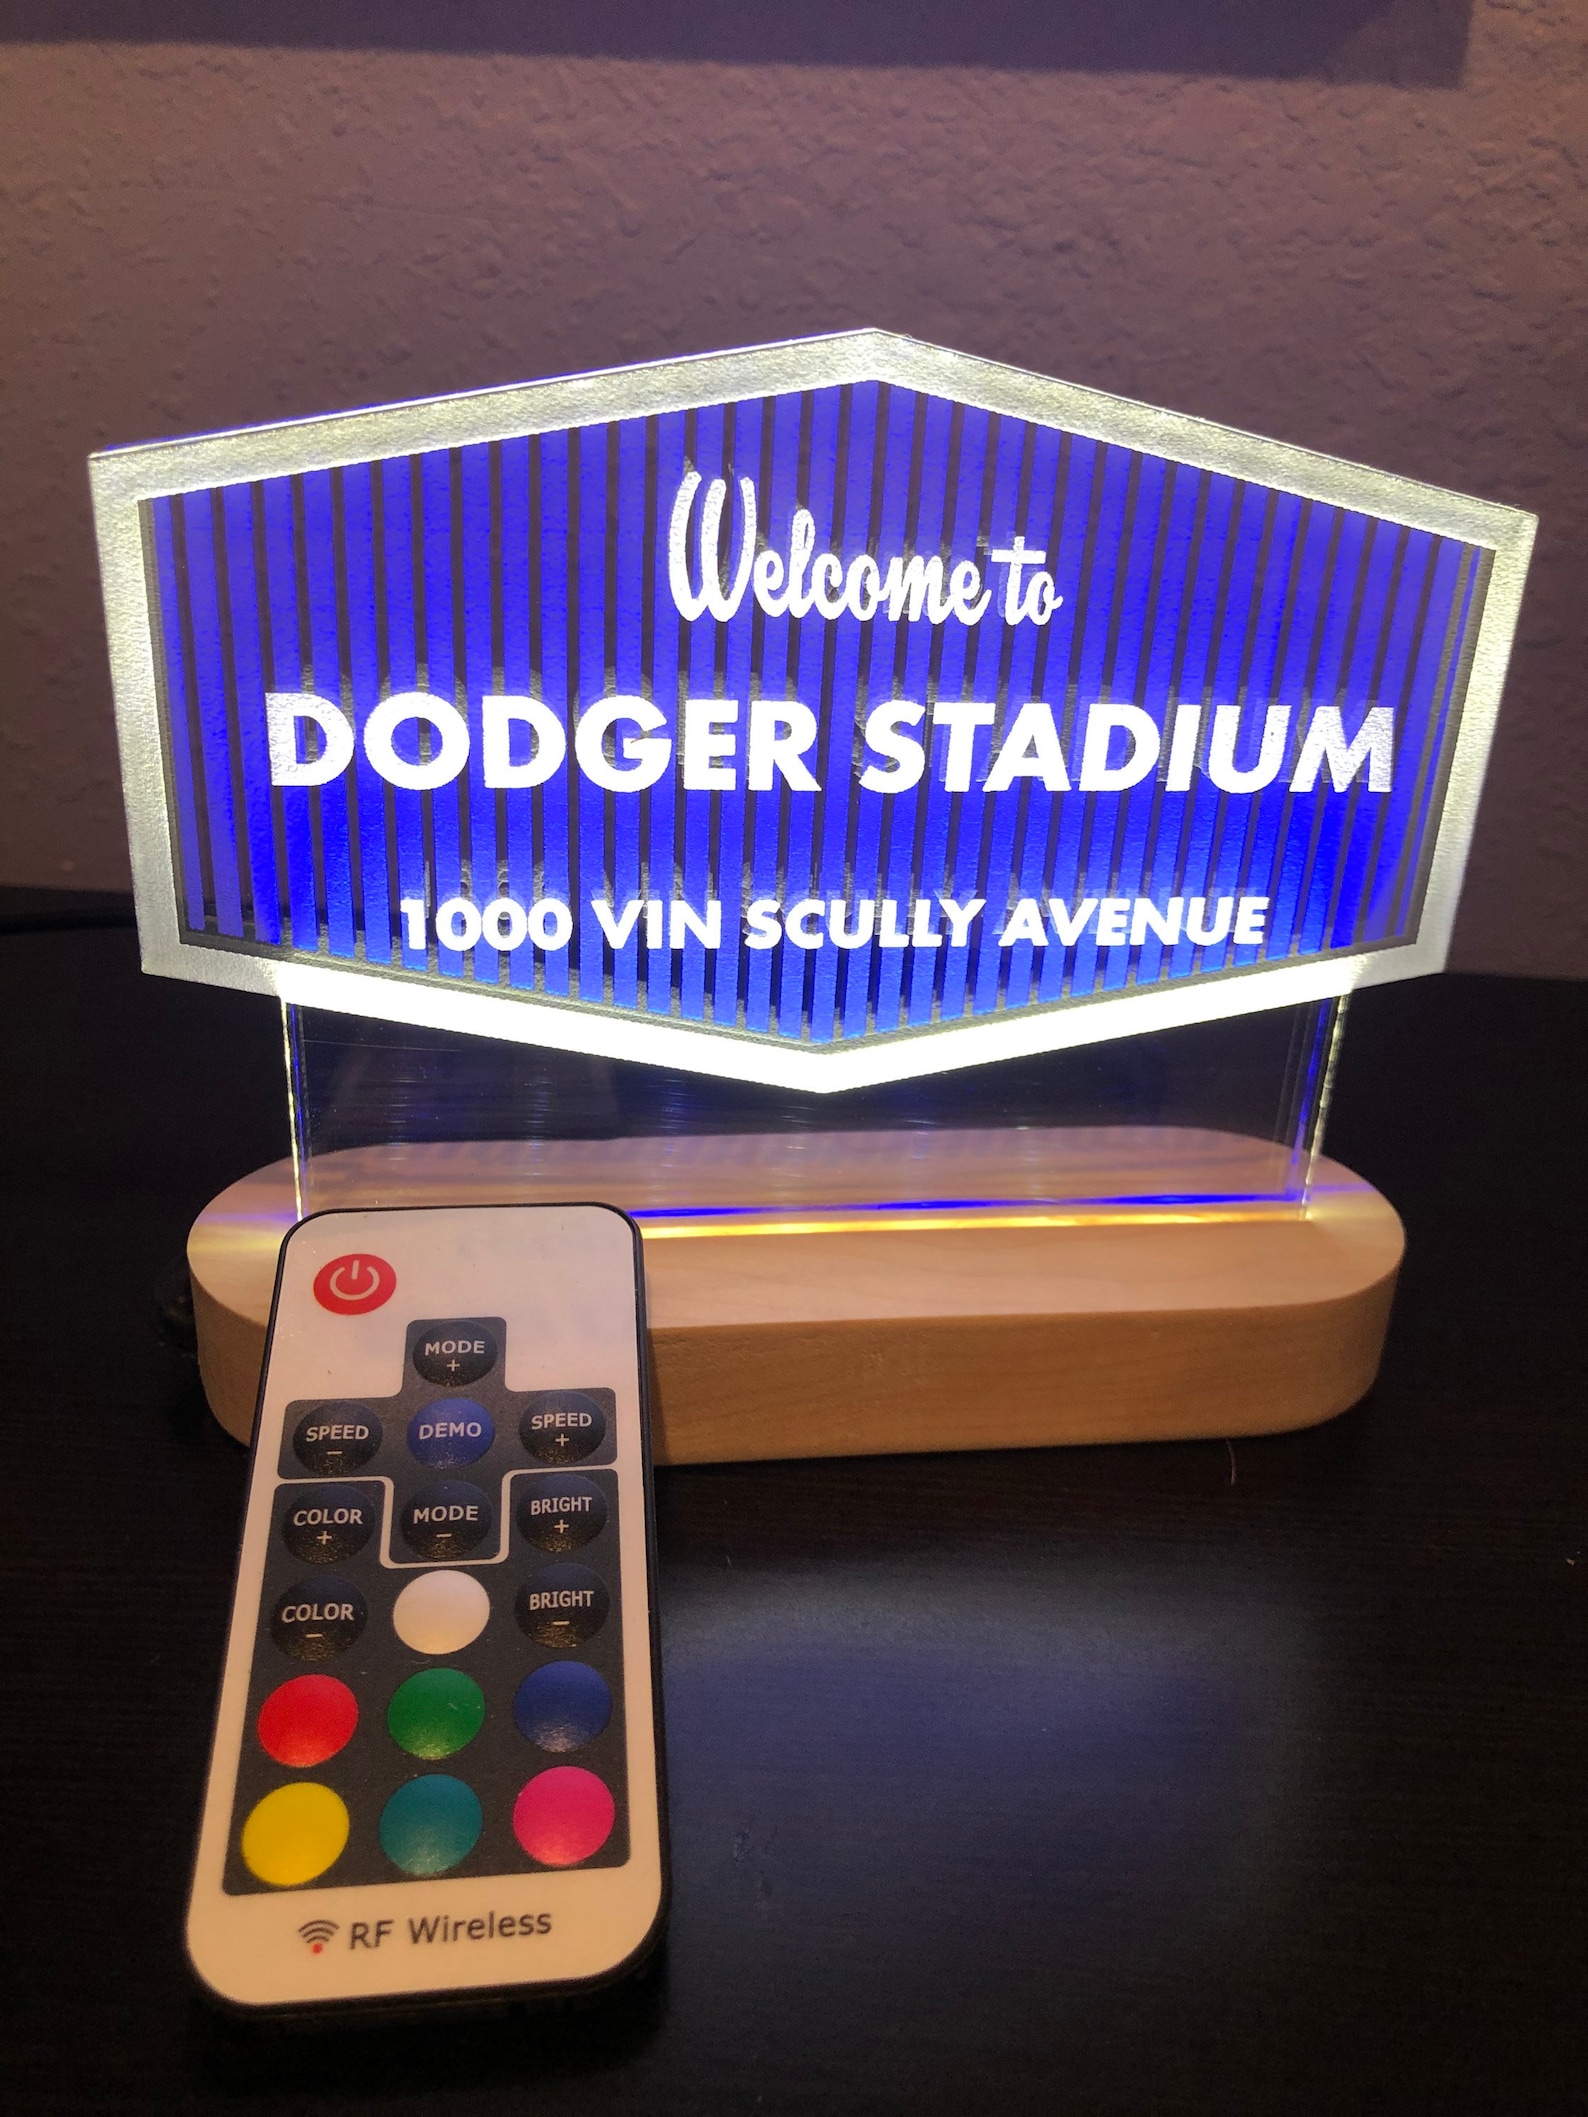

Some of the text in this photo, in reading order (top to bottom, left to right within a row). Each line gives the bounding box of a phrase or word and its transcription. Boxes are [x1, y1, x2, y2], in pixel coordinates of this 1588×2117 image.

[669, 470, 1063, 626] Welcome to
[265, 692, 1395, 794] DODGER STADIUM
[400, 896, 1269, 952] 1000 VIN SCULLY AVENUE
[425, 1340, 485, 1356] MODE
[531, 1412, 592, 1430] SPEED
[305, 1425, 369, 1442] SPEED
[418, 1422, 482, 1440] DEMO
[413, 1505, 479, 1524] MODE
[530, 1496, 592, 1516] BRIGHT
[293, 1508, 363, 1526] COLOR
[529, 1590, 594, 1610] BRIGHT
[281, 1603, 354, 1622] COLOR
[349, 1911, 552, 1950] RF Wireless
